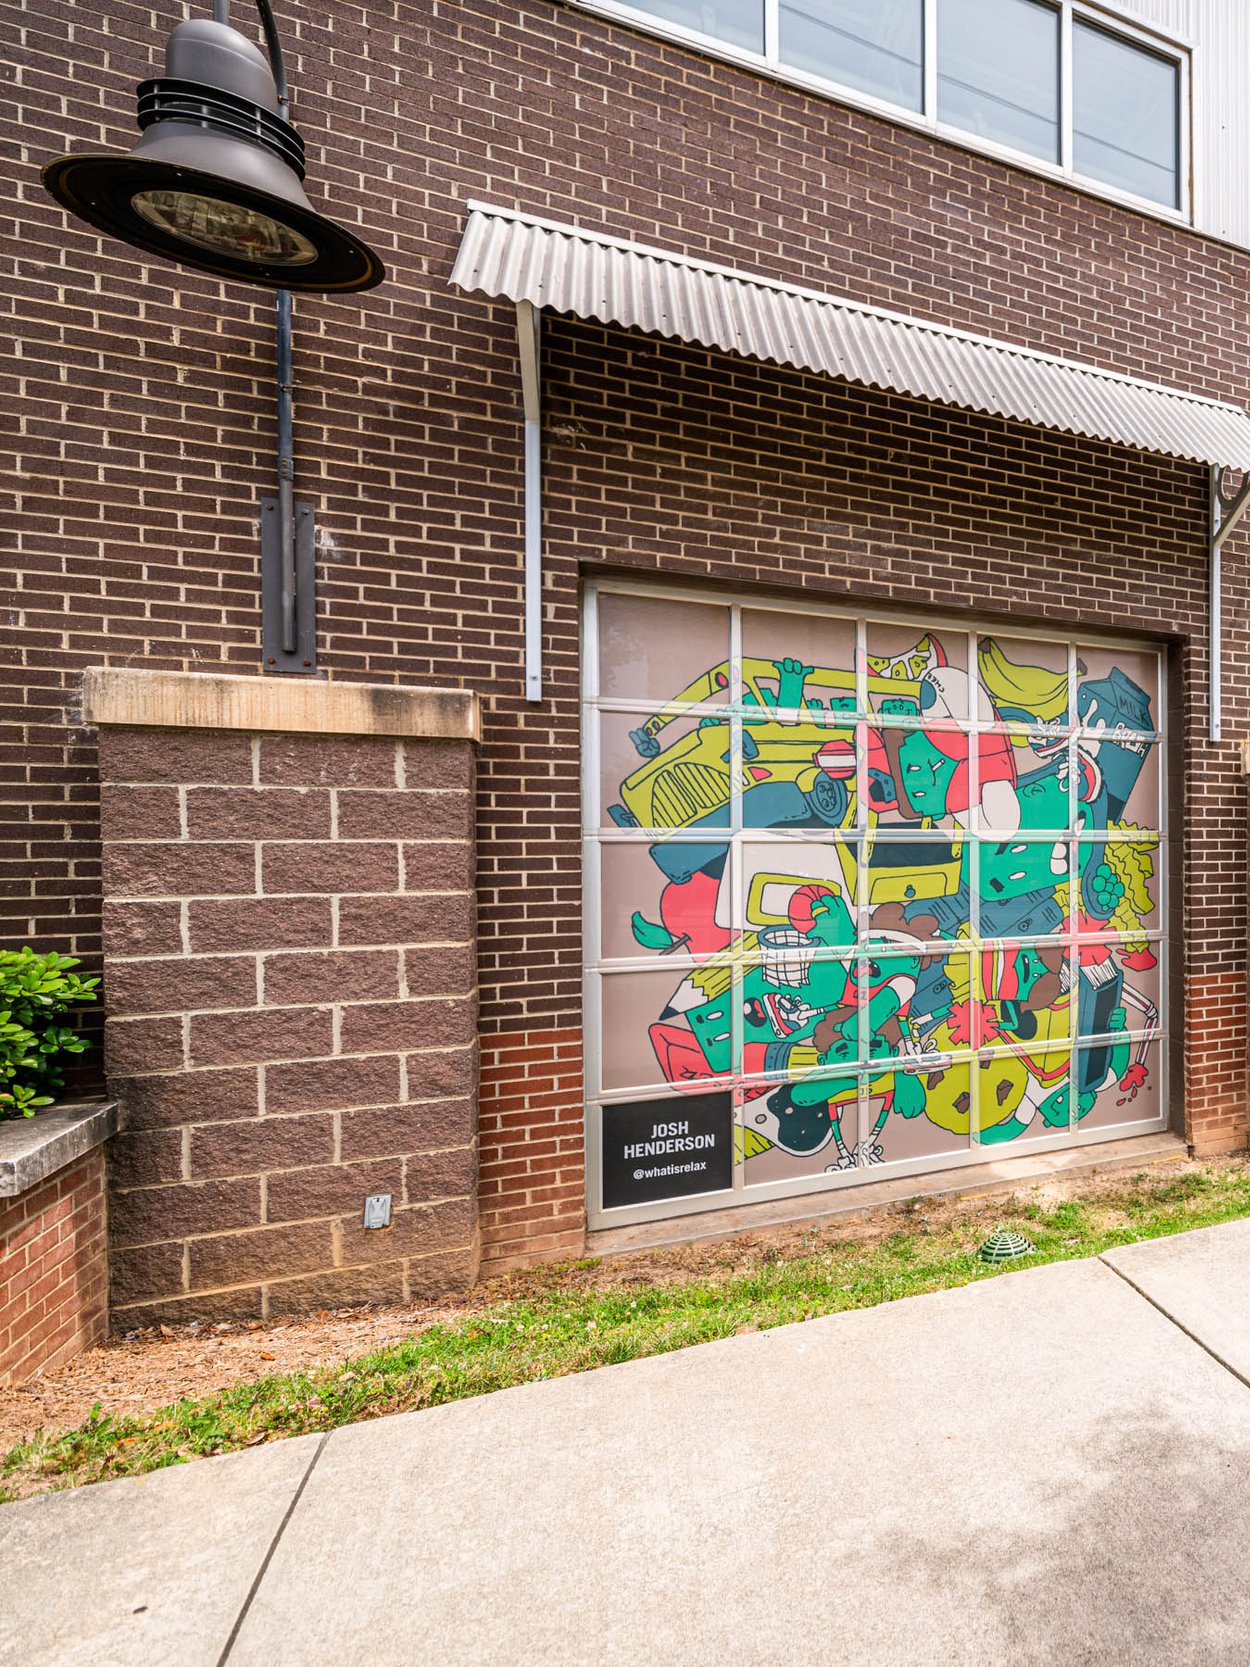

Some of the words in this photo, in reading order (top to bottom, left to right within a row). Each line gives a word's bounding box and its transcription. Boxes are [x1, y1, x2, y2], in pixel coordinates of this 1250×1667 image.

[1118, 695, 1151, 727] MILK
[650, 1121, 689, 1140] JOSH
[623, 1134, 716, 1160] HENDERSON
[633, 1161, 707, 1180] @whatisrelax
